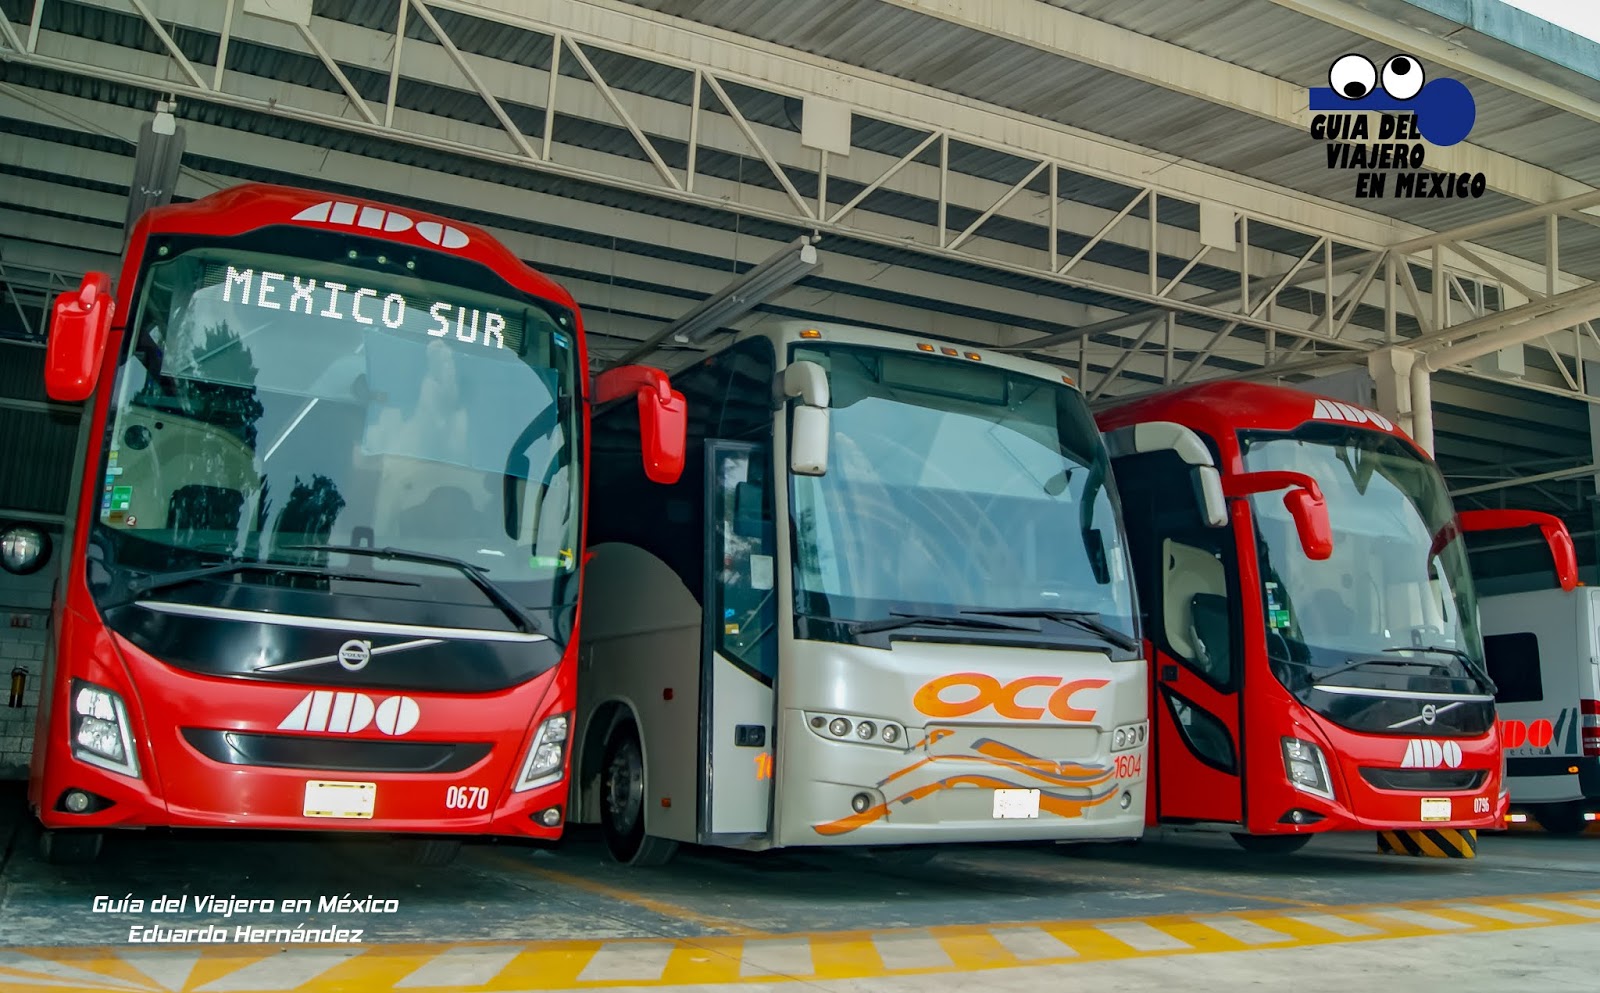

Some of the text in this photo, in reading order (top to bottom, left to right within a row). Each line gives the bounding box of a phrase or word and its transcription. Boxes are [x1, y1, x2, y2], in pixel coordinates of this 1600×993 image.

[291, 201, 470, 249] ADO
[223, 266, 506, 349] MEXICO SUR
[1312, 398, 1394, 432] ADO
[276, 690, 420, 735] ADO
[913, 672, 1112, 723] OCC
[1500, 718, 1553, 748] DO
[1114, 754, 1142, 779] 1604
[1400, 739, 1462, 768] ADO
[446, 785, 490, 810] 0670
